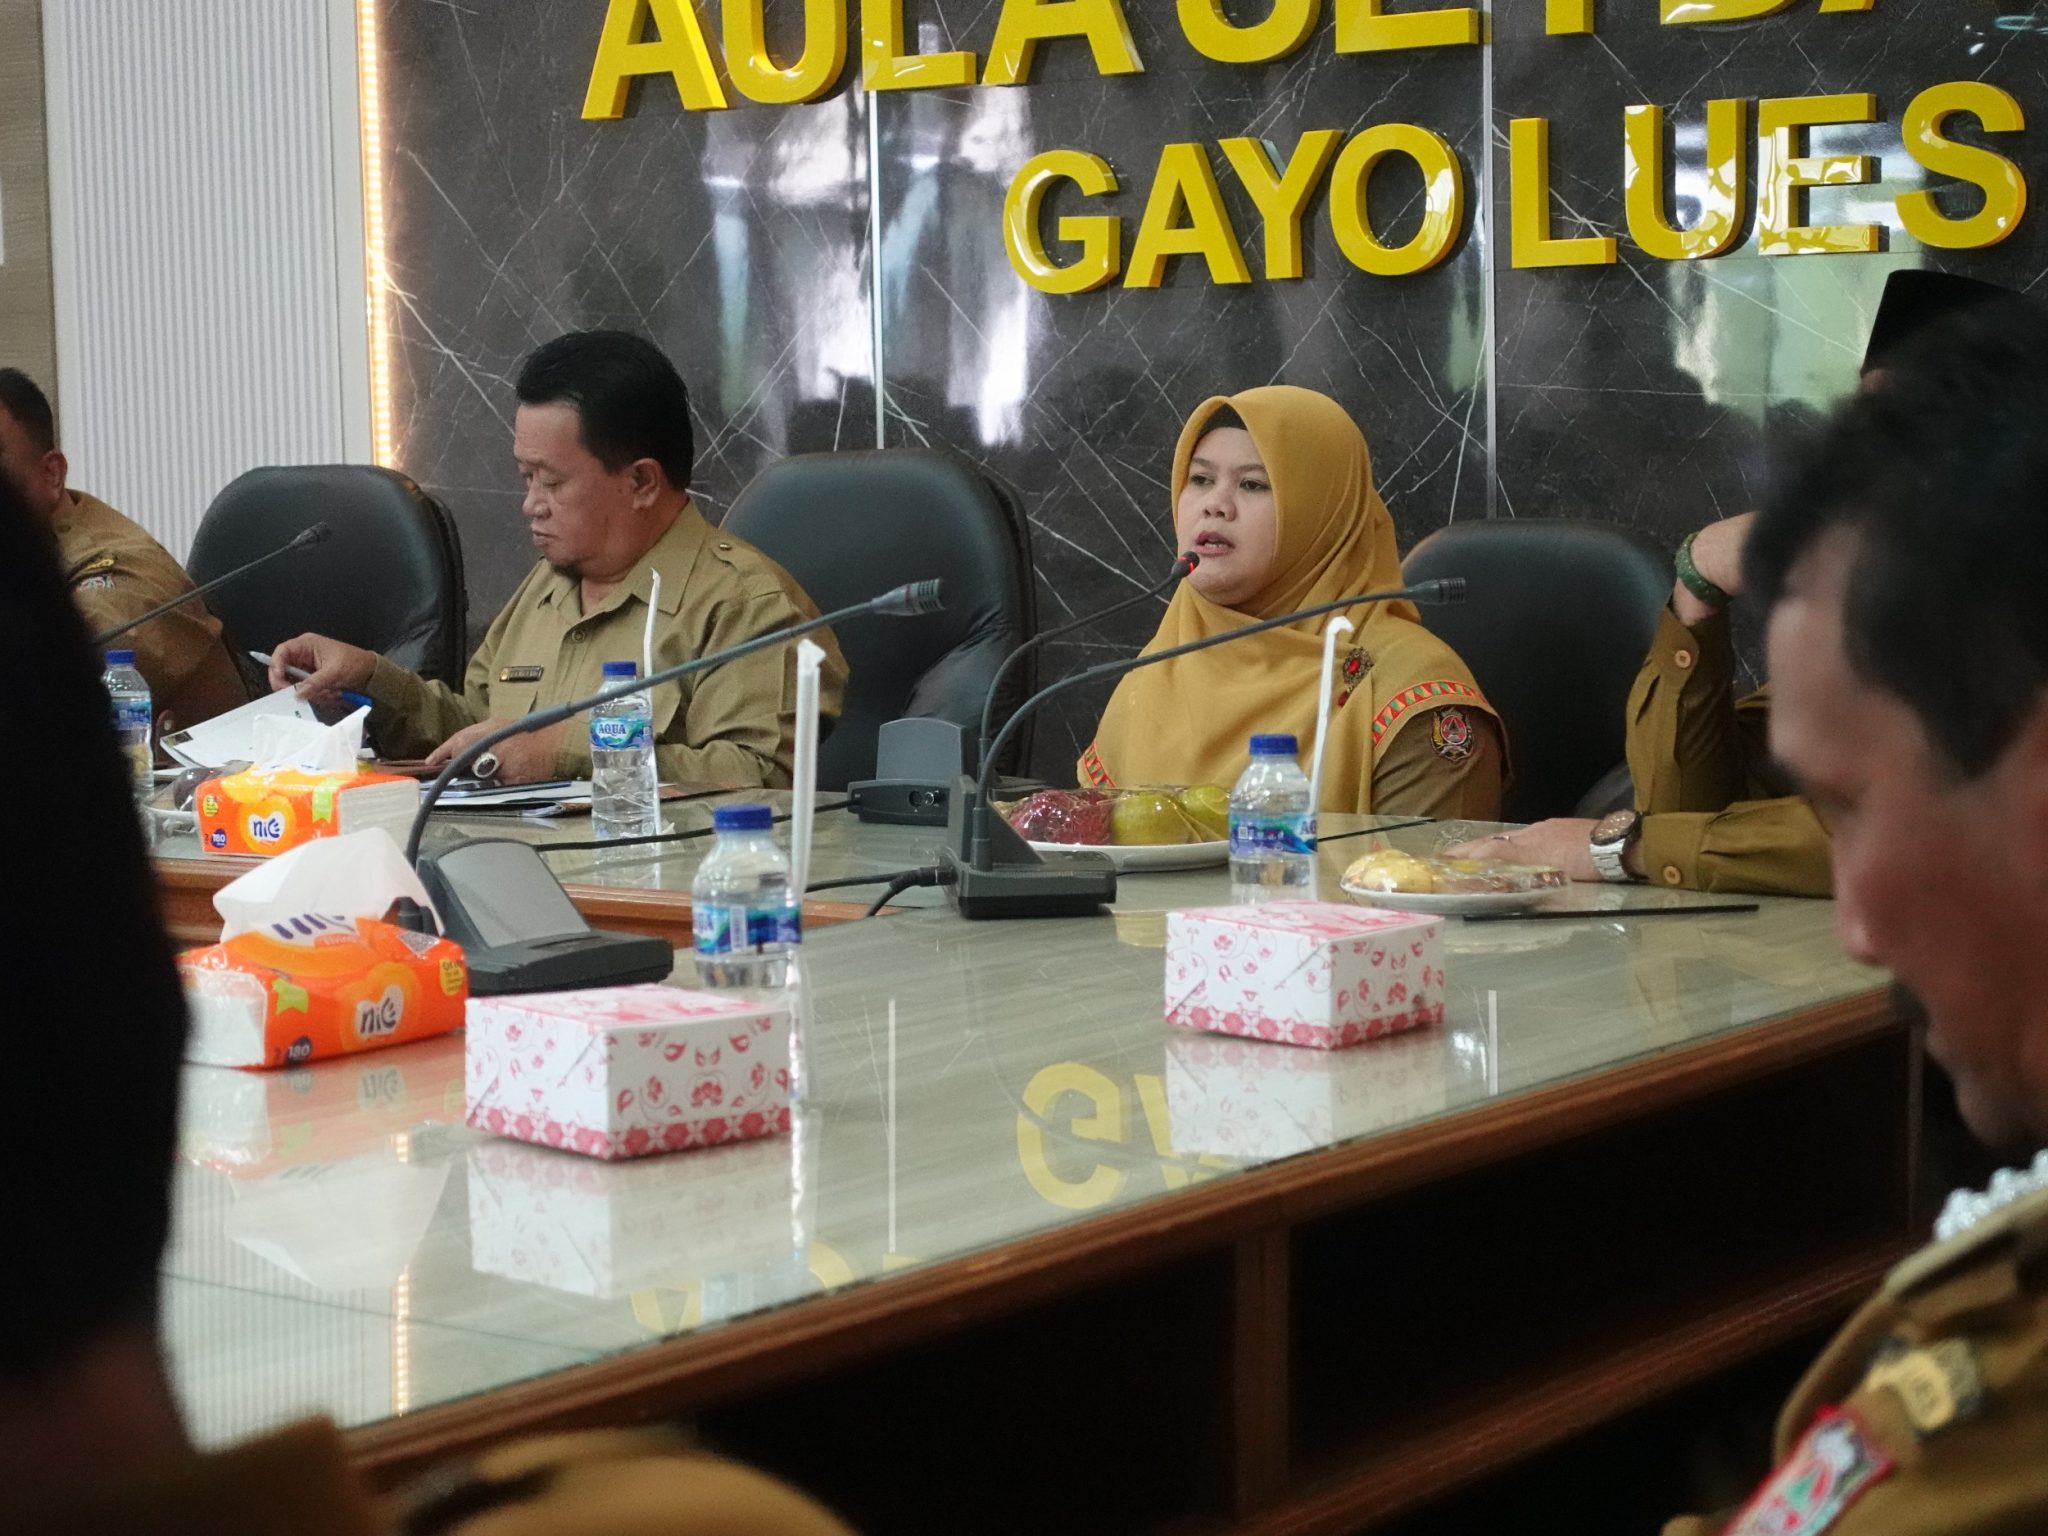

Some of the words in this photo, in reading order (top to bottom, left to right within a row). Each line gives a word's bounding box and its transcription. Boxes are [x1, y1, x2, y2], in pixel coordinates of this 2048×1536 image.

[1003, 123, 1464, 294] GAYO
[1510, 81, 2028, 269] LUES
[599, 723, 626, 737] AQUA
[287, 1044, 311, 1059] 180
